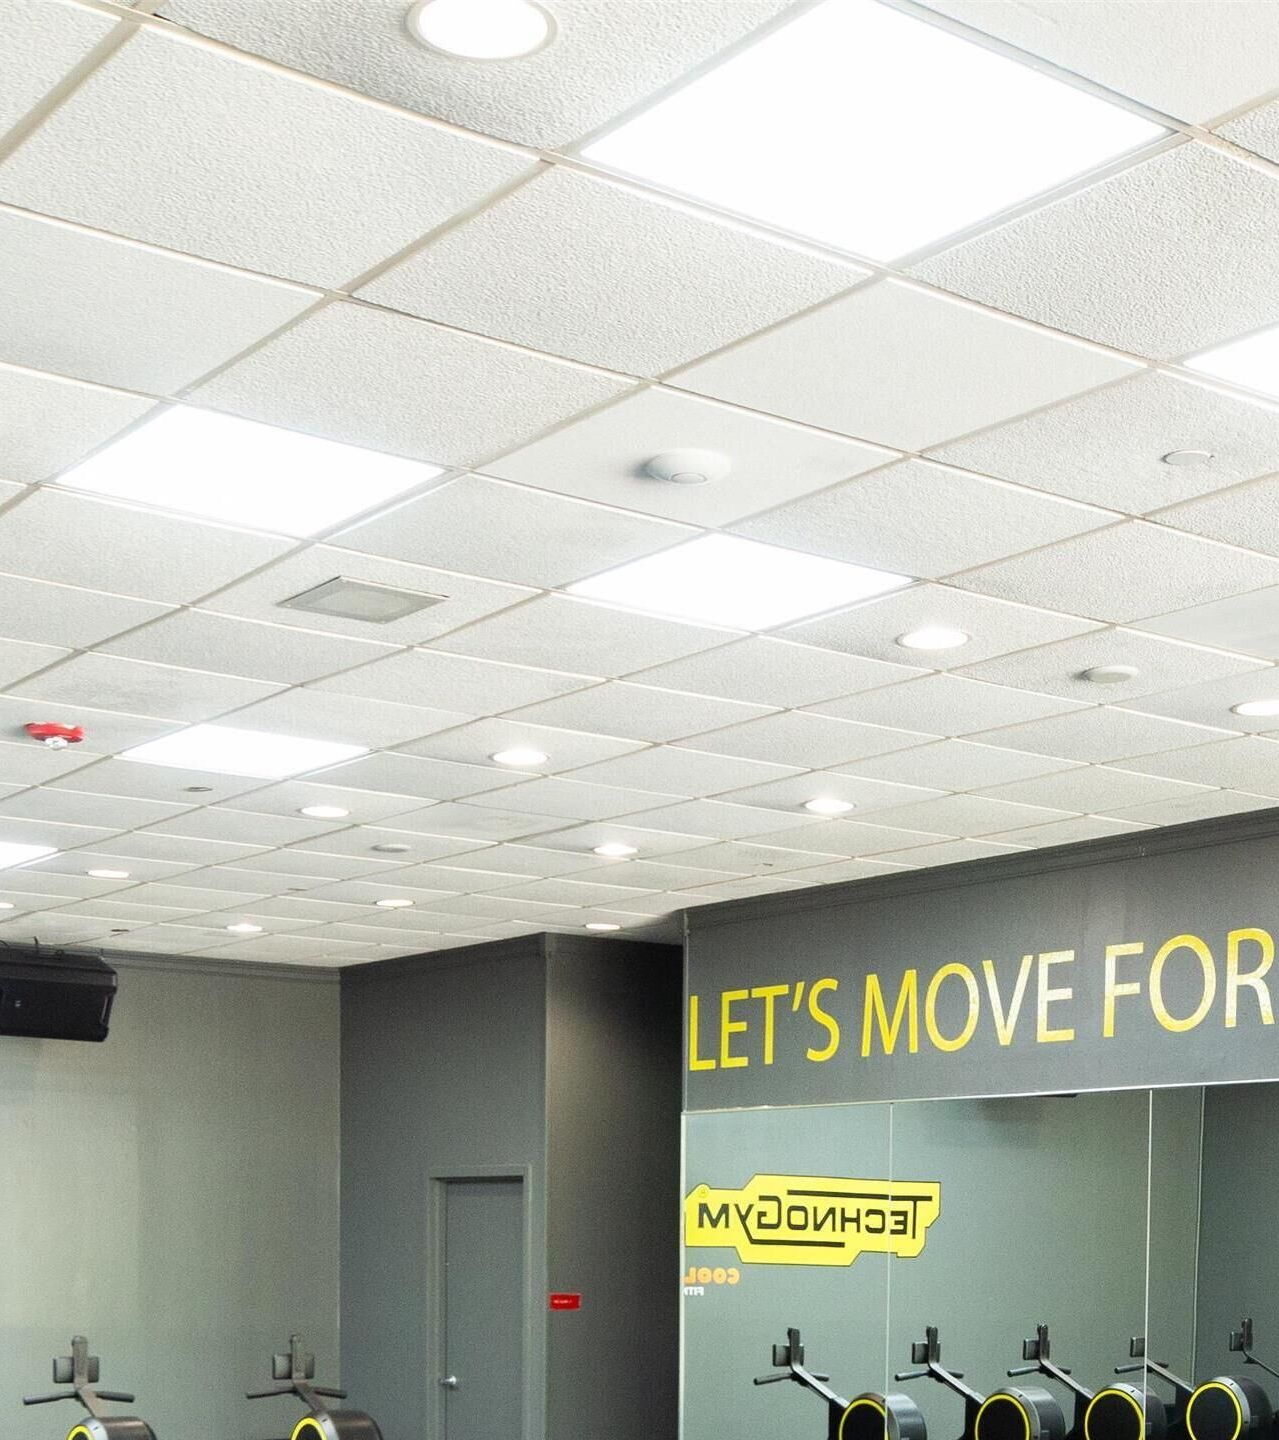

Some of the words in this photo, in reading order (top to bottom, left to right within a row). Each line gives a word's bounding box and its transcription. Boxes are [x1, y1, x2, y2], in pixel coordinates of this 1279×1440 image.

[687, 977, 840, 1072] LET'S
[860, 949, 1075, 1059] MOVE
[1103, 926, 1275, 1038] FOR
